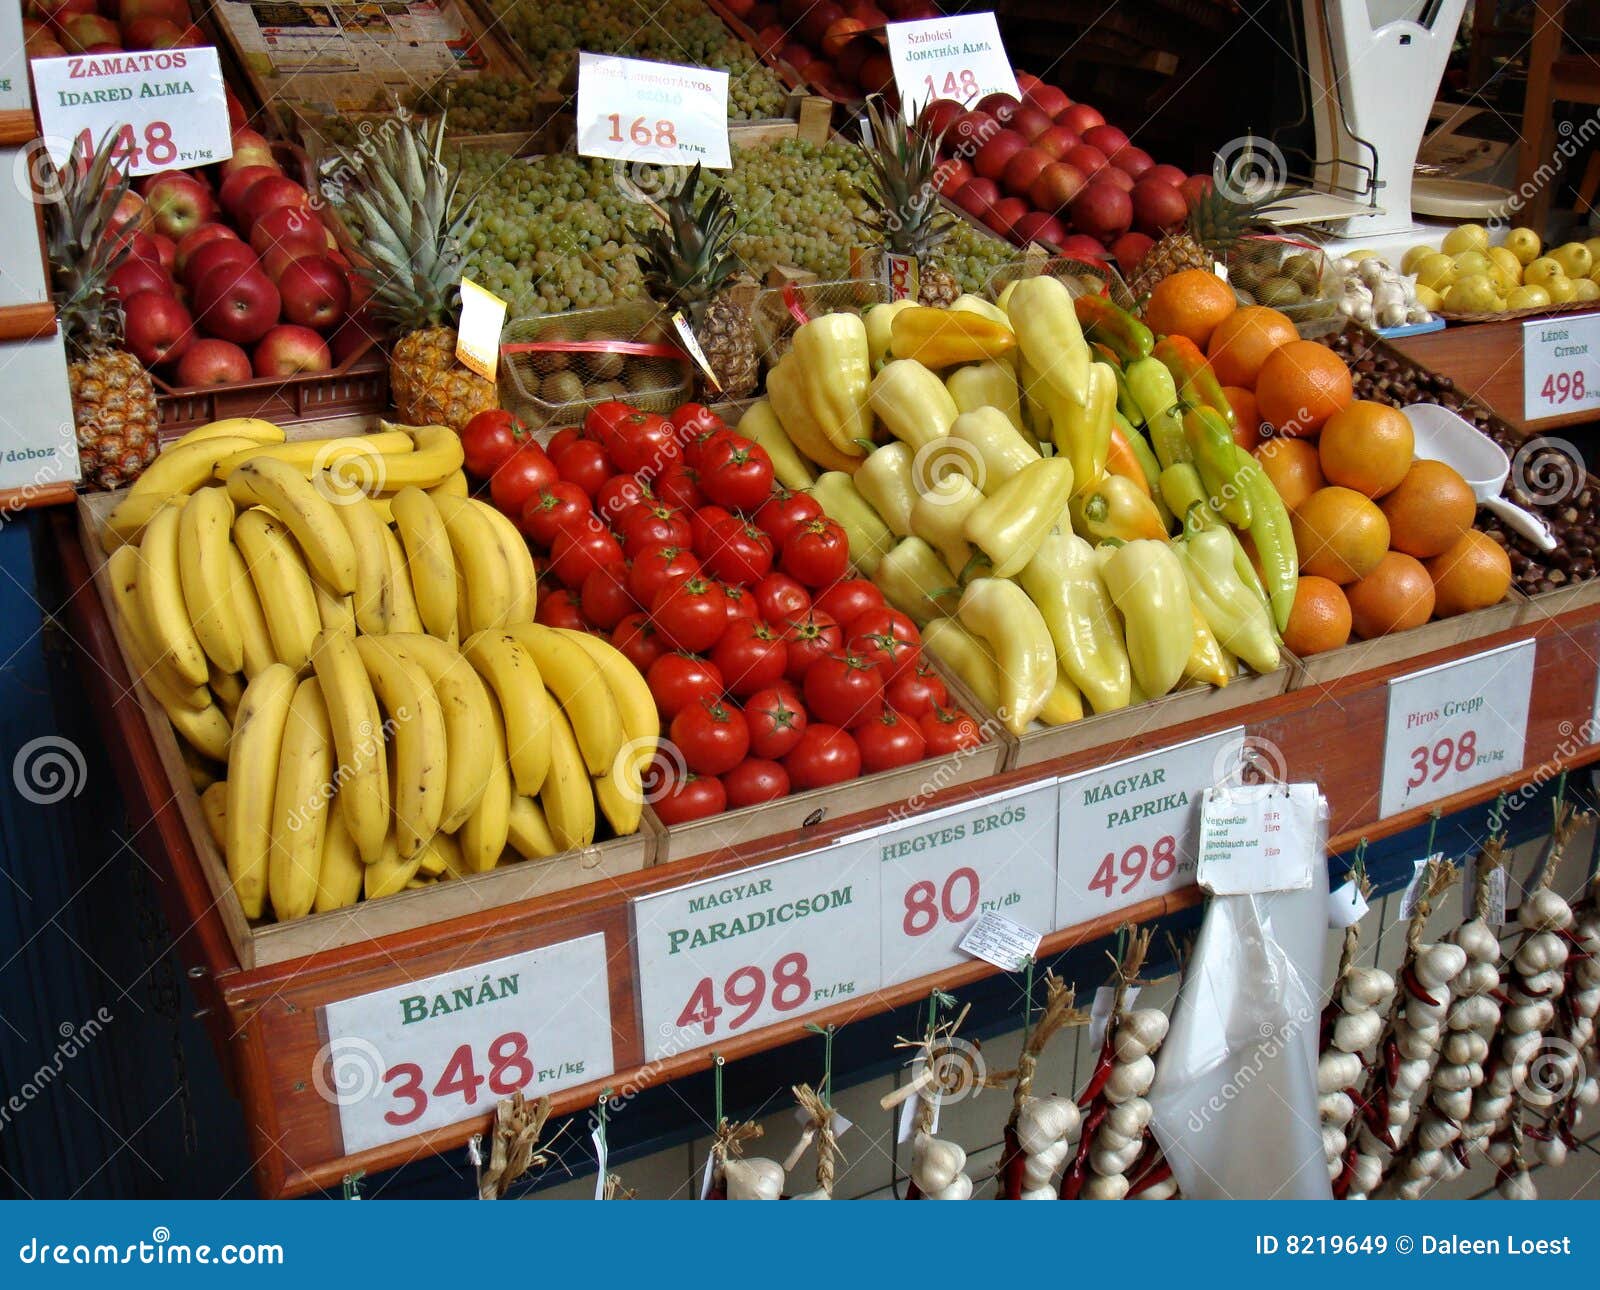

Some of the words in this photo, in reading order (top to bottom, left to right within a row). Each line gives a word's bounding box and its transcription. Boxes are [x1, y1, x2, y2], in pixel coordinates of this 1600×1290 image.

[905, 44, 960, 62] JONATHÁN
[963, 41, 991, 54] ALMA
[907, 29, 952, 45] Szabolcsi
[68, 52, 187, 79] ZAMATOS
[58, 86, 133, 107] IDARED
[139, 81, 195, 99] ALMA
[924, 70, 981, 102] 148
[76, 121, 178, 168] 148
[180, 149, 213, 161] Ft/kg
[608, 112, 677, 148] 168
[1540, 370, 1585, 405] 498
[1406, 708, 1439, 729] Piros
[1443, 695, 1484, 718] Grepp
[1408, 730, 1477, 788] 398
[1476, 750, 1505, 766] Ft/kg
[1083, 768, 1167, 807] MAGYAR
[1107, 791, 1189, 829] PAPRIKA
[881, 824, 966, 863] HEGYES
[1088, 835, 1177, 898] 498
[688, 878, 774, 914] MAGYAR
[903, 866, 981, 937] 80
[980, 892, 1022, 914] Ft/db
[668, 886, 853, 955] PARADICSOM
[400, 974, 520, 1026] BANÁN
[676, 952, 812, 1036] 498
[813, 981, 856, 1001] Ft/kg
[381, 1031, 535, 1127] 348
[537, 1060, 586, 1083] Ft/kg
